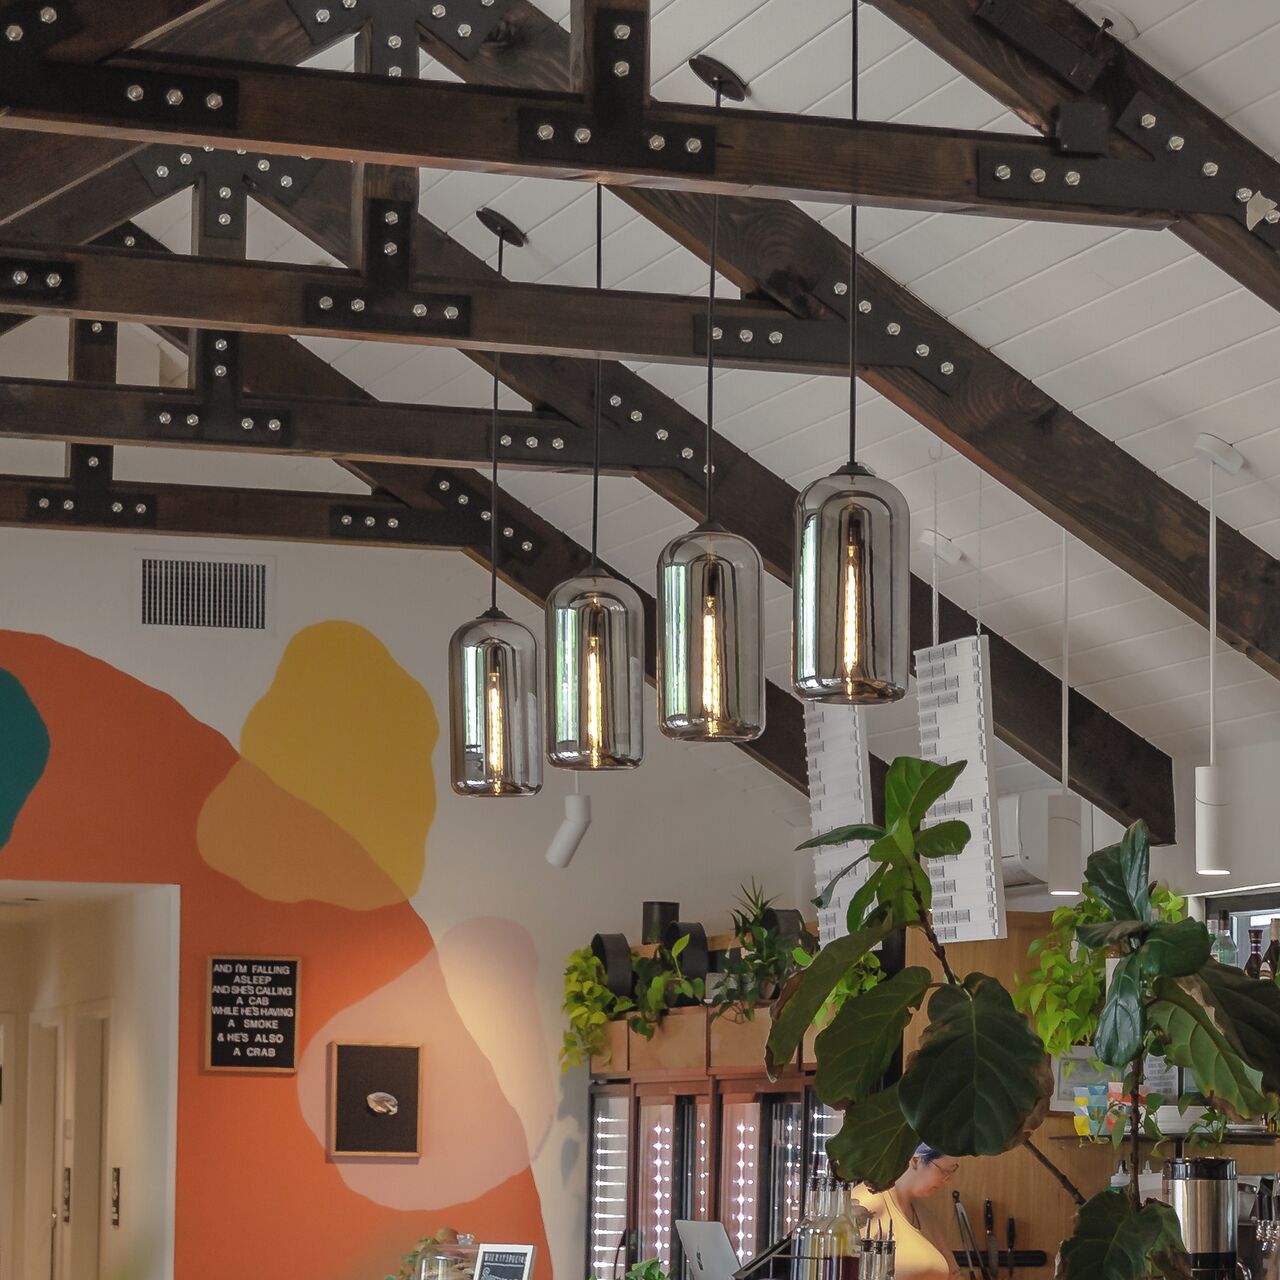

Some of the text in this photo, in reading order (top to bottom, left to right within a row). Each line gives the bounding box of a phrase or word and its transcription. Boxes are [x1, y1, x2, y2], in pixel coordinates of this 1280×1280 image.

[214, 964, 290, 974] AND I'M FALLING
[234, 975, 272, 984] ASLEEP
[212, 985, 292, 996] AND SHE'S CALLING
[236, 996, 269, 1006] A CAB
[211, 1006, 294, 1017] WHILE HE'S HAVING
[227, 1019, 279, 1029] A SMOKE
[217, 1032, 284, 1043] & HE'S ALSO
[233, 1047, 276, 1057] A CRAB
